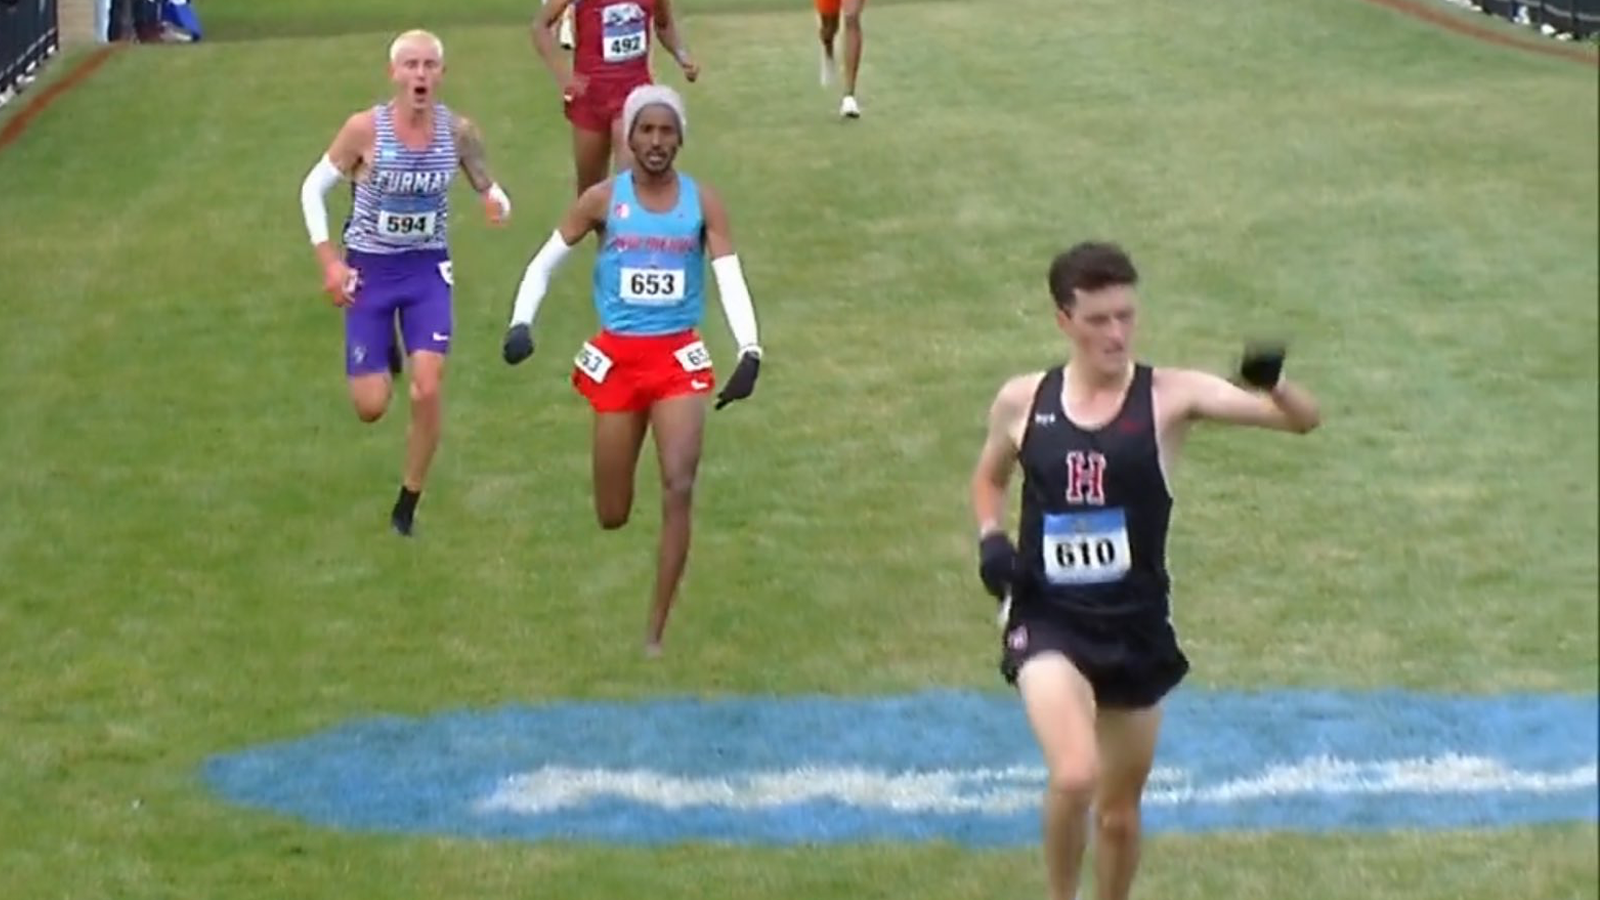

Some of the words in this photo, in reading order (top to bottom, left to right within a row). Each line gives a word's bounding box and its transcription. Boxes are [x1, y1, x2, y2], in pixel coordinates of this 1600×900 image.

[611, 36, 640, 54] 492
[387, 216, 426, 233] 594
[631, 274, 675, 295] 653
[1066, 451, 1106, 505] H
[1055, 538, 1115, 568] 610
